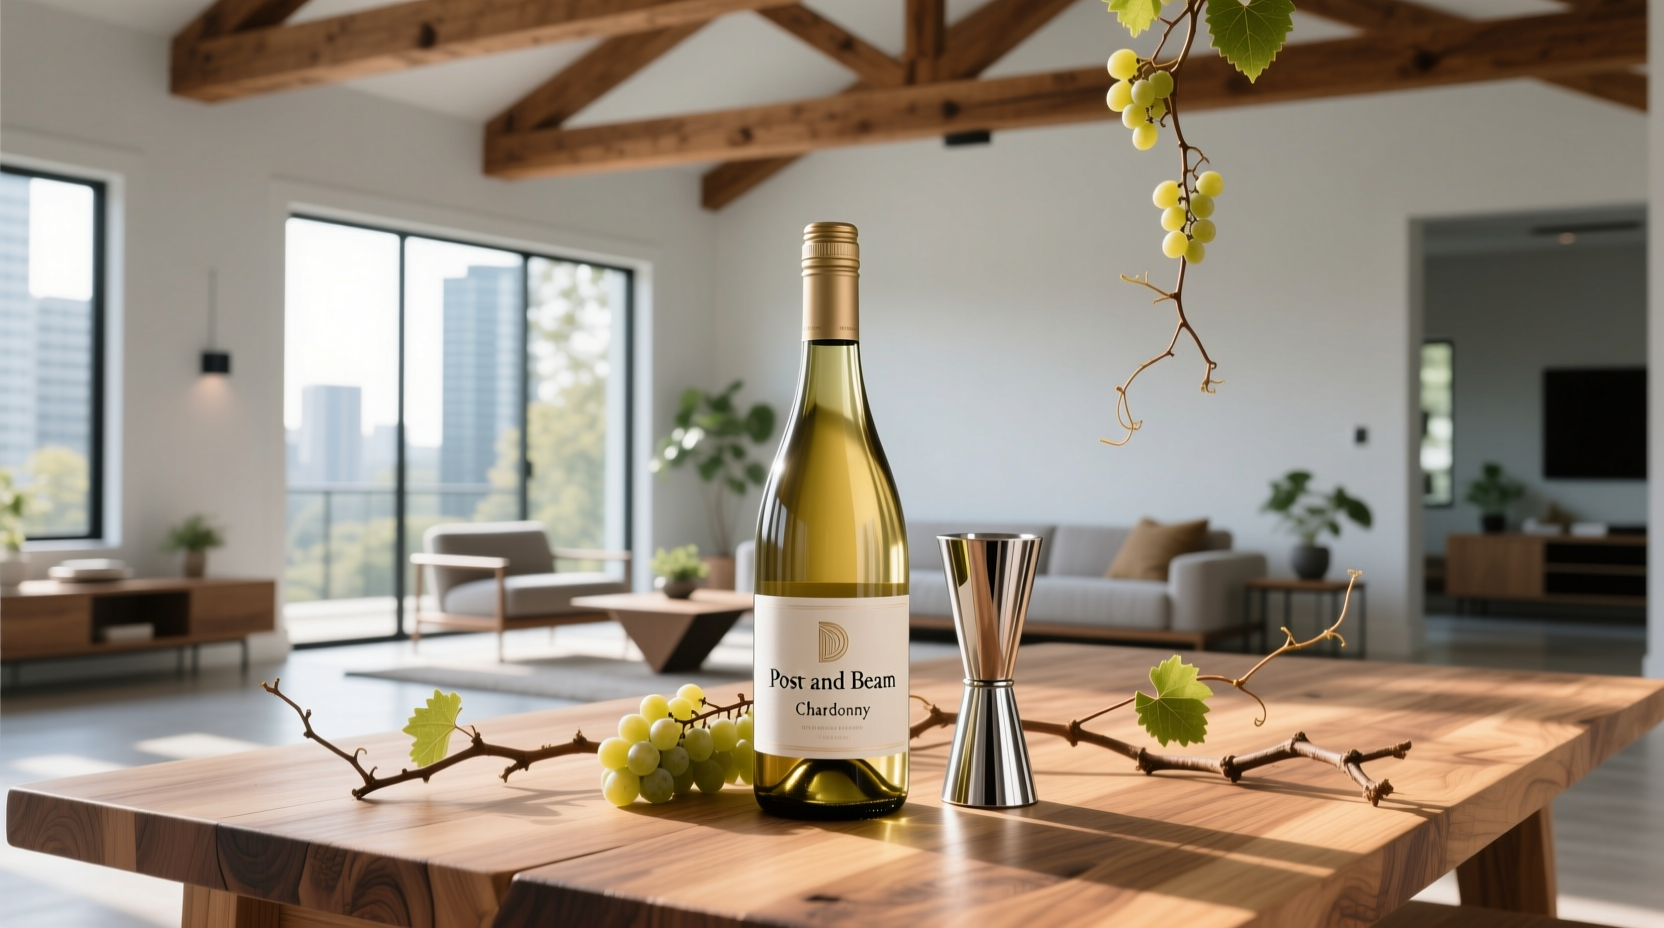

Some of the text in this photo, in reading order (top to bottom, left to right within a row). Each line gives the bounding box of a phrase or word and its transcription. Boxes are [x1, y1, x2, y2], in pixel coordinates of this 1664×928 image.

[769, 668, 896, 690] Post and Beam
[795, 701, 871, 720] Chardonny
